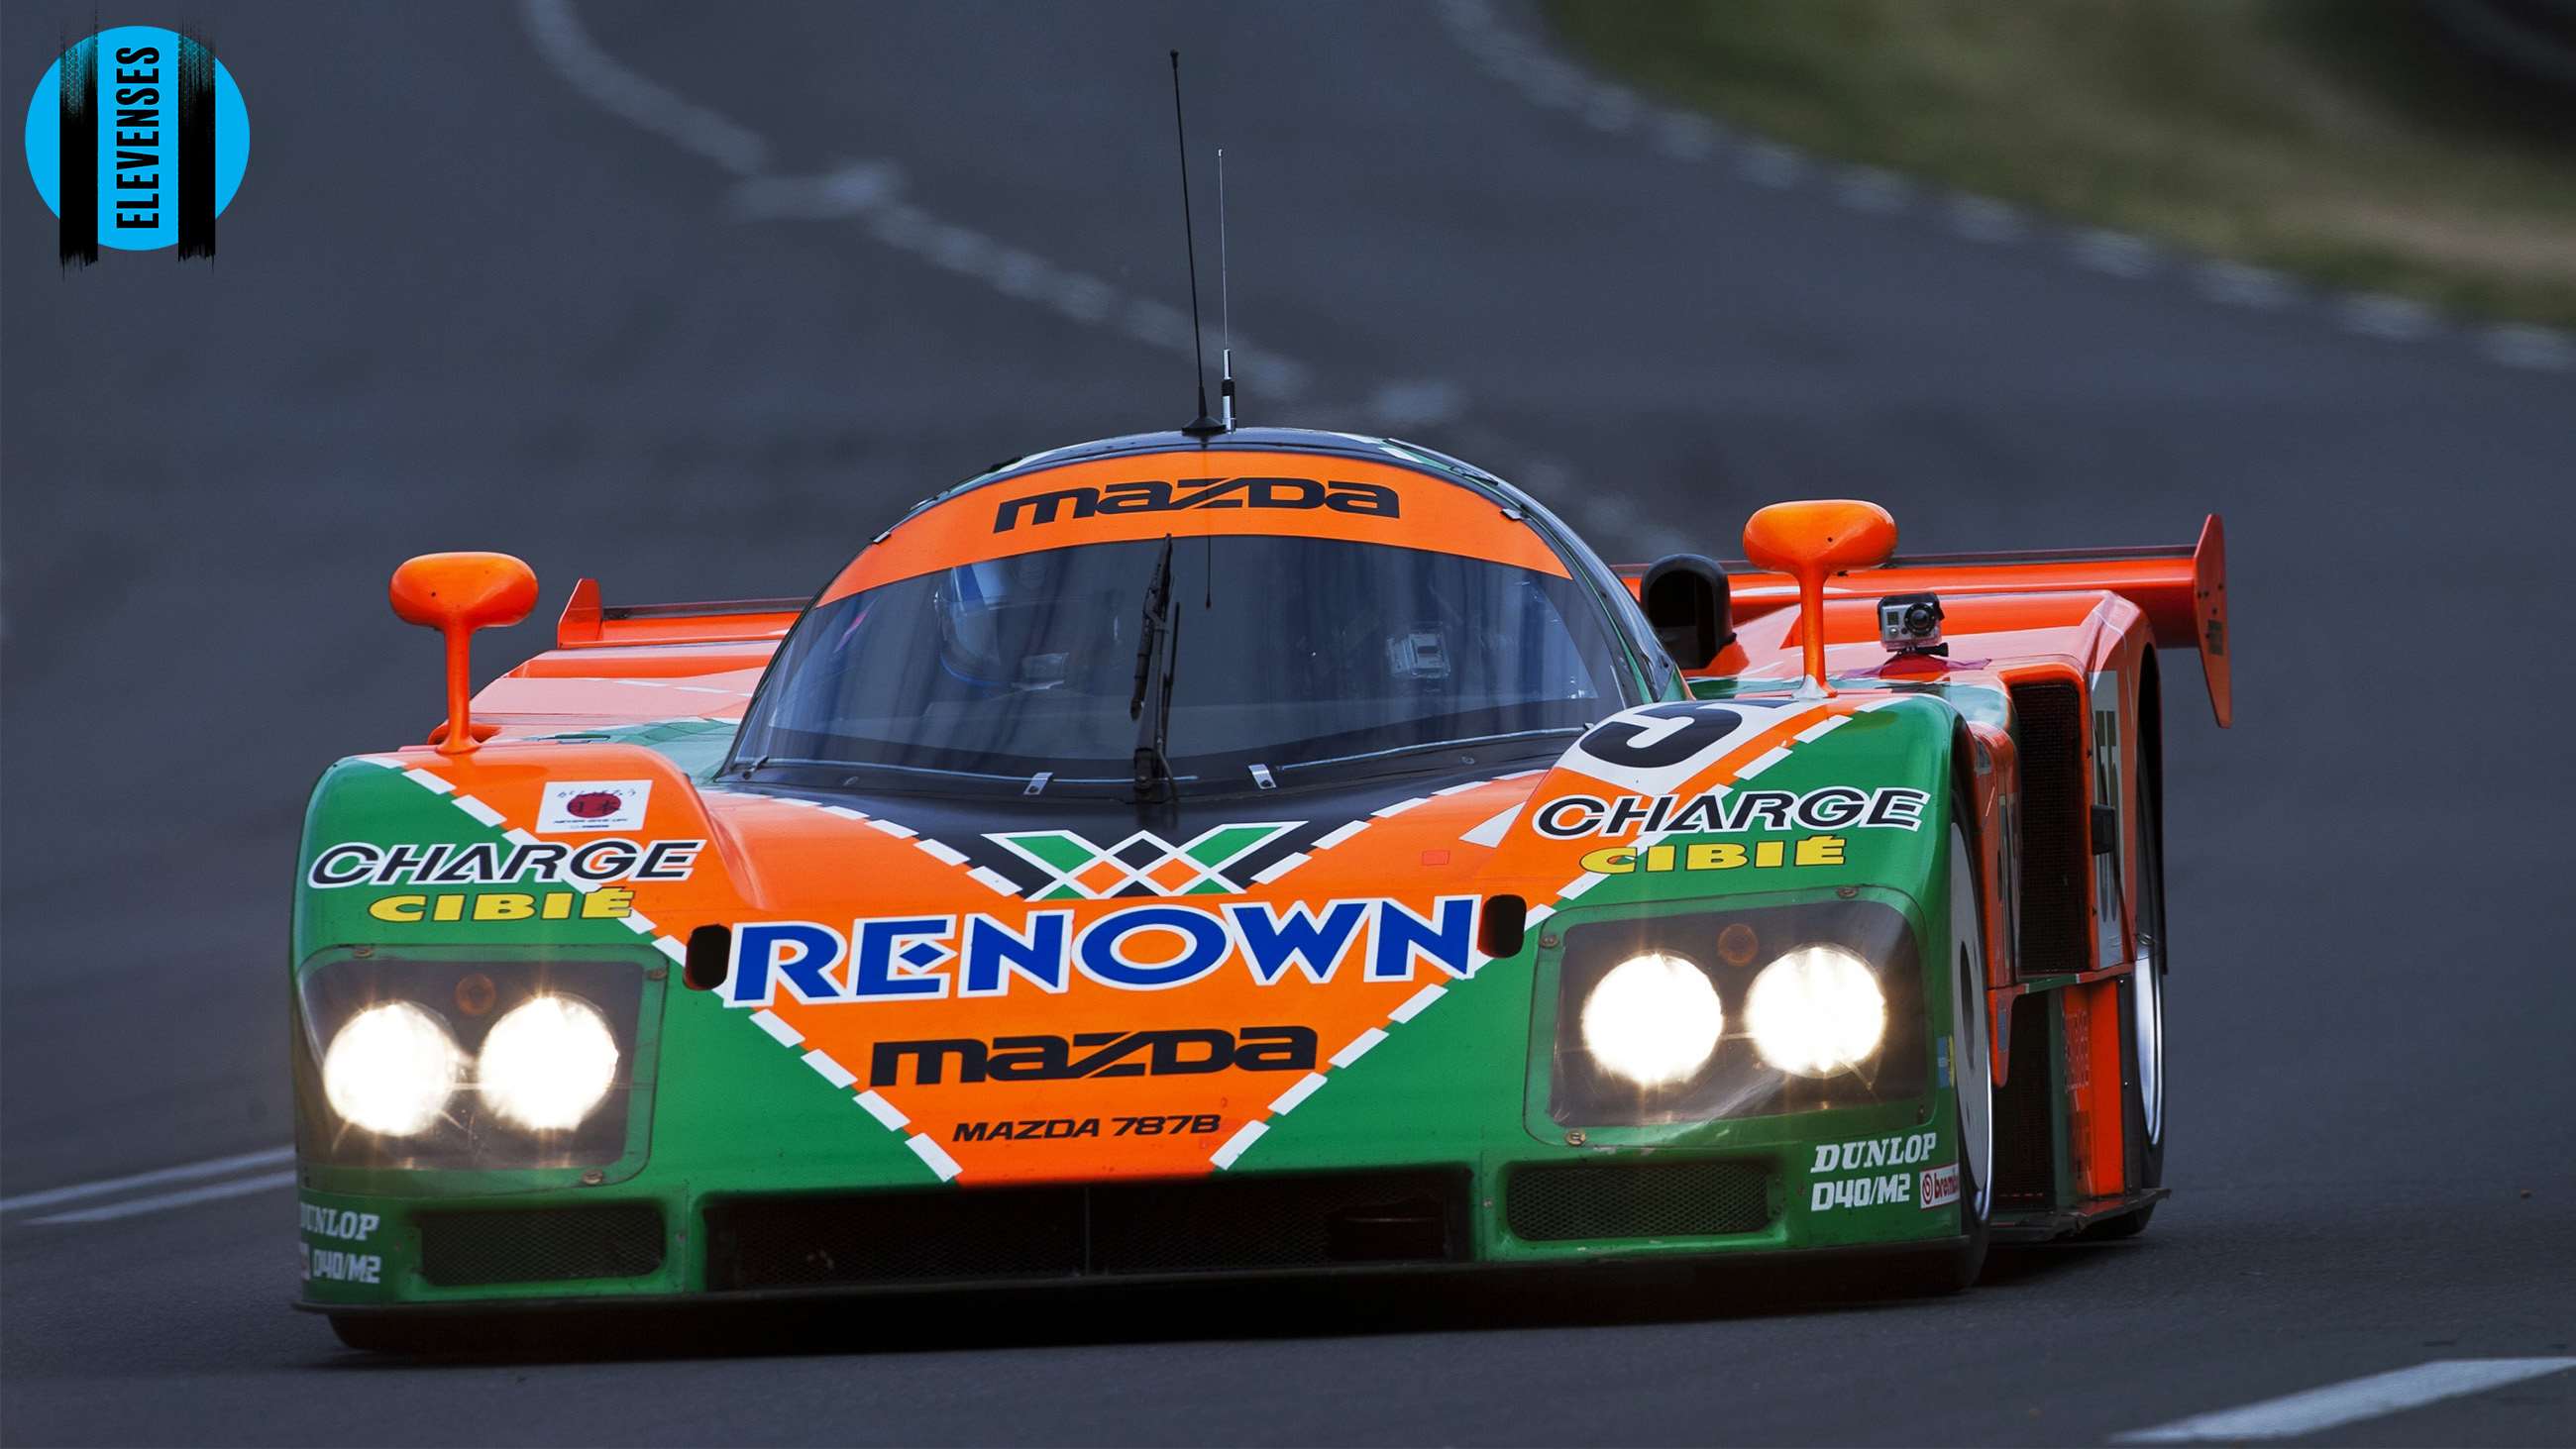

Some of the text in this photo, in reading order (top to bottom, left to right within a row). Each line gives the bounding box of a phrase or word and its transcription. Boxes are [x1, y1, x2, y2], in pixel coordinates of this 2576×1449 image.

[993, 476, 1401, 534] mazda
[1532, 785, 1931, 840] CHARGE
[307, 838, 707, 888] CHARGE
[1579, 834, 1847, 875] CIBIÉ
[368, 885, 635, 922] CIBIÉ
[723, 894, 1483, 1007] RENOWN
[870, 1024, 1319, 1087] mazda
[952, 1114, 1221, 1141] MAZDA 787B
[1810, 1132, 1937, 1173] DUNLOP
[1810, 1173, 1911, 1211] D40/M2
[313, 1248, 380, 1284] D40/M2
